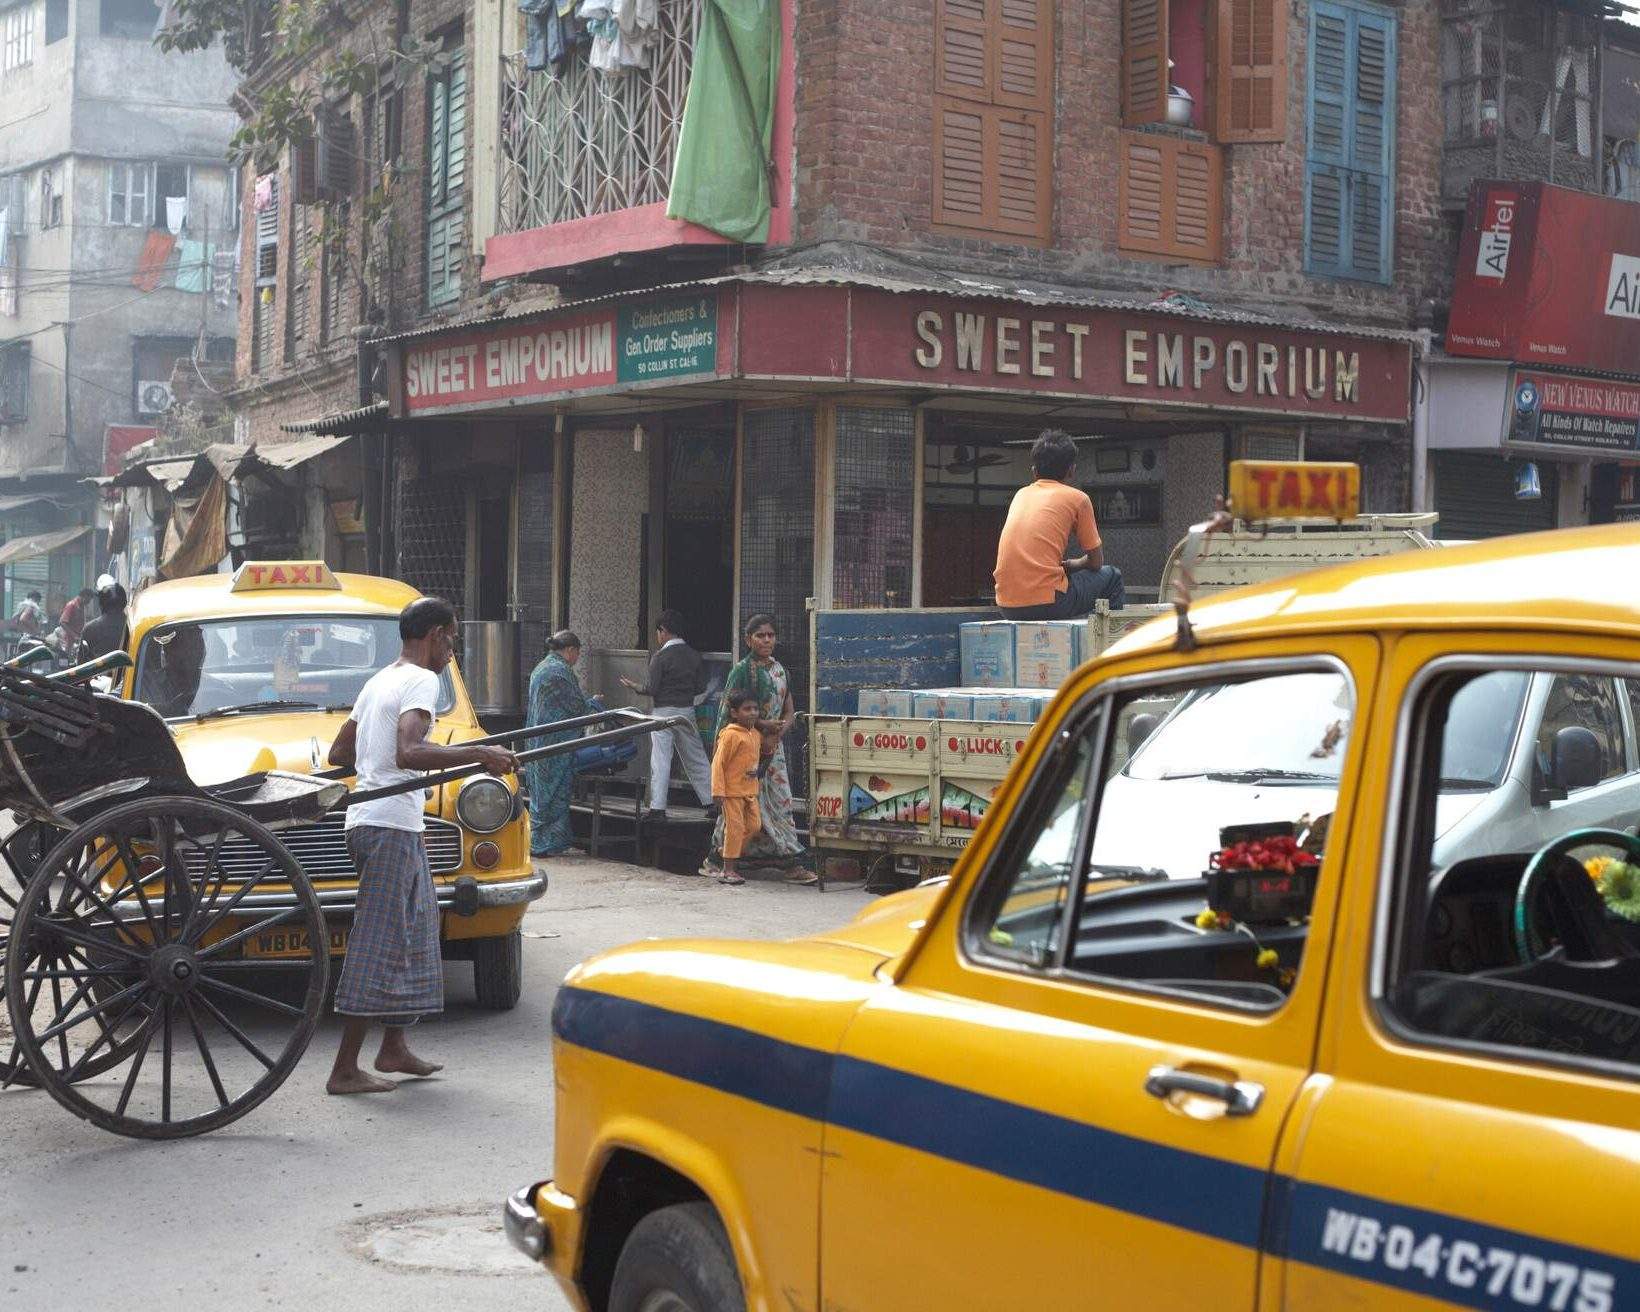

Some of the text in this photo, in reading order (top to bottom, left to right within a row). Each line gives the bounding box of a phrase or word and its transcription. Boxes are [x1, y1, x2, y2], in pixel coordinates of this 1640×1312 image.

[1485, 199, 1514, 274] Airtel
[1609, 271, 1640, 313] Ai
[632, 299, 707, 329] Confectioners &
[643, 333, 668, 354] Order
[671, 327, 712, 353] Suppliers
[1475, 335, 1501, 349] Watch
[1548, 343, 1567, 355] Watch
[406, 321, 612, 398] SWEET EMPORIUM
[914, 310, 1361, 403] SWEET EMPORIUM
[1543, 382, 1640, 415] NEW VENUS WATCH
[1541, 412, 1637, 437] All Kinds Of Watch Repairers
[1248, 468, 1348, 514] TAXI
[248, 565, 323, 585] TAXI
[874, 733, 1004, 755] GOOD LUCK
[817, 796, 842, 817] STOP
